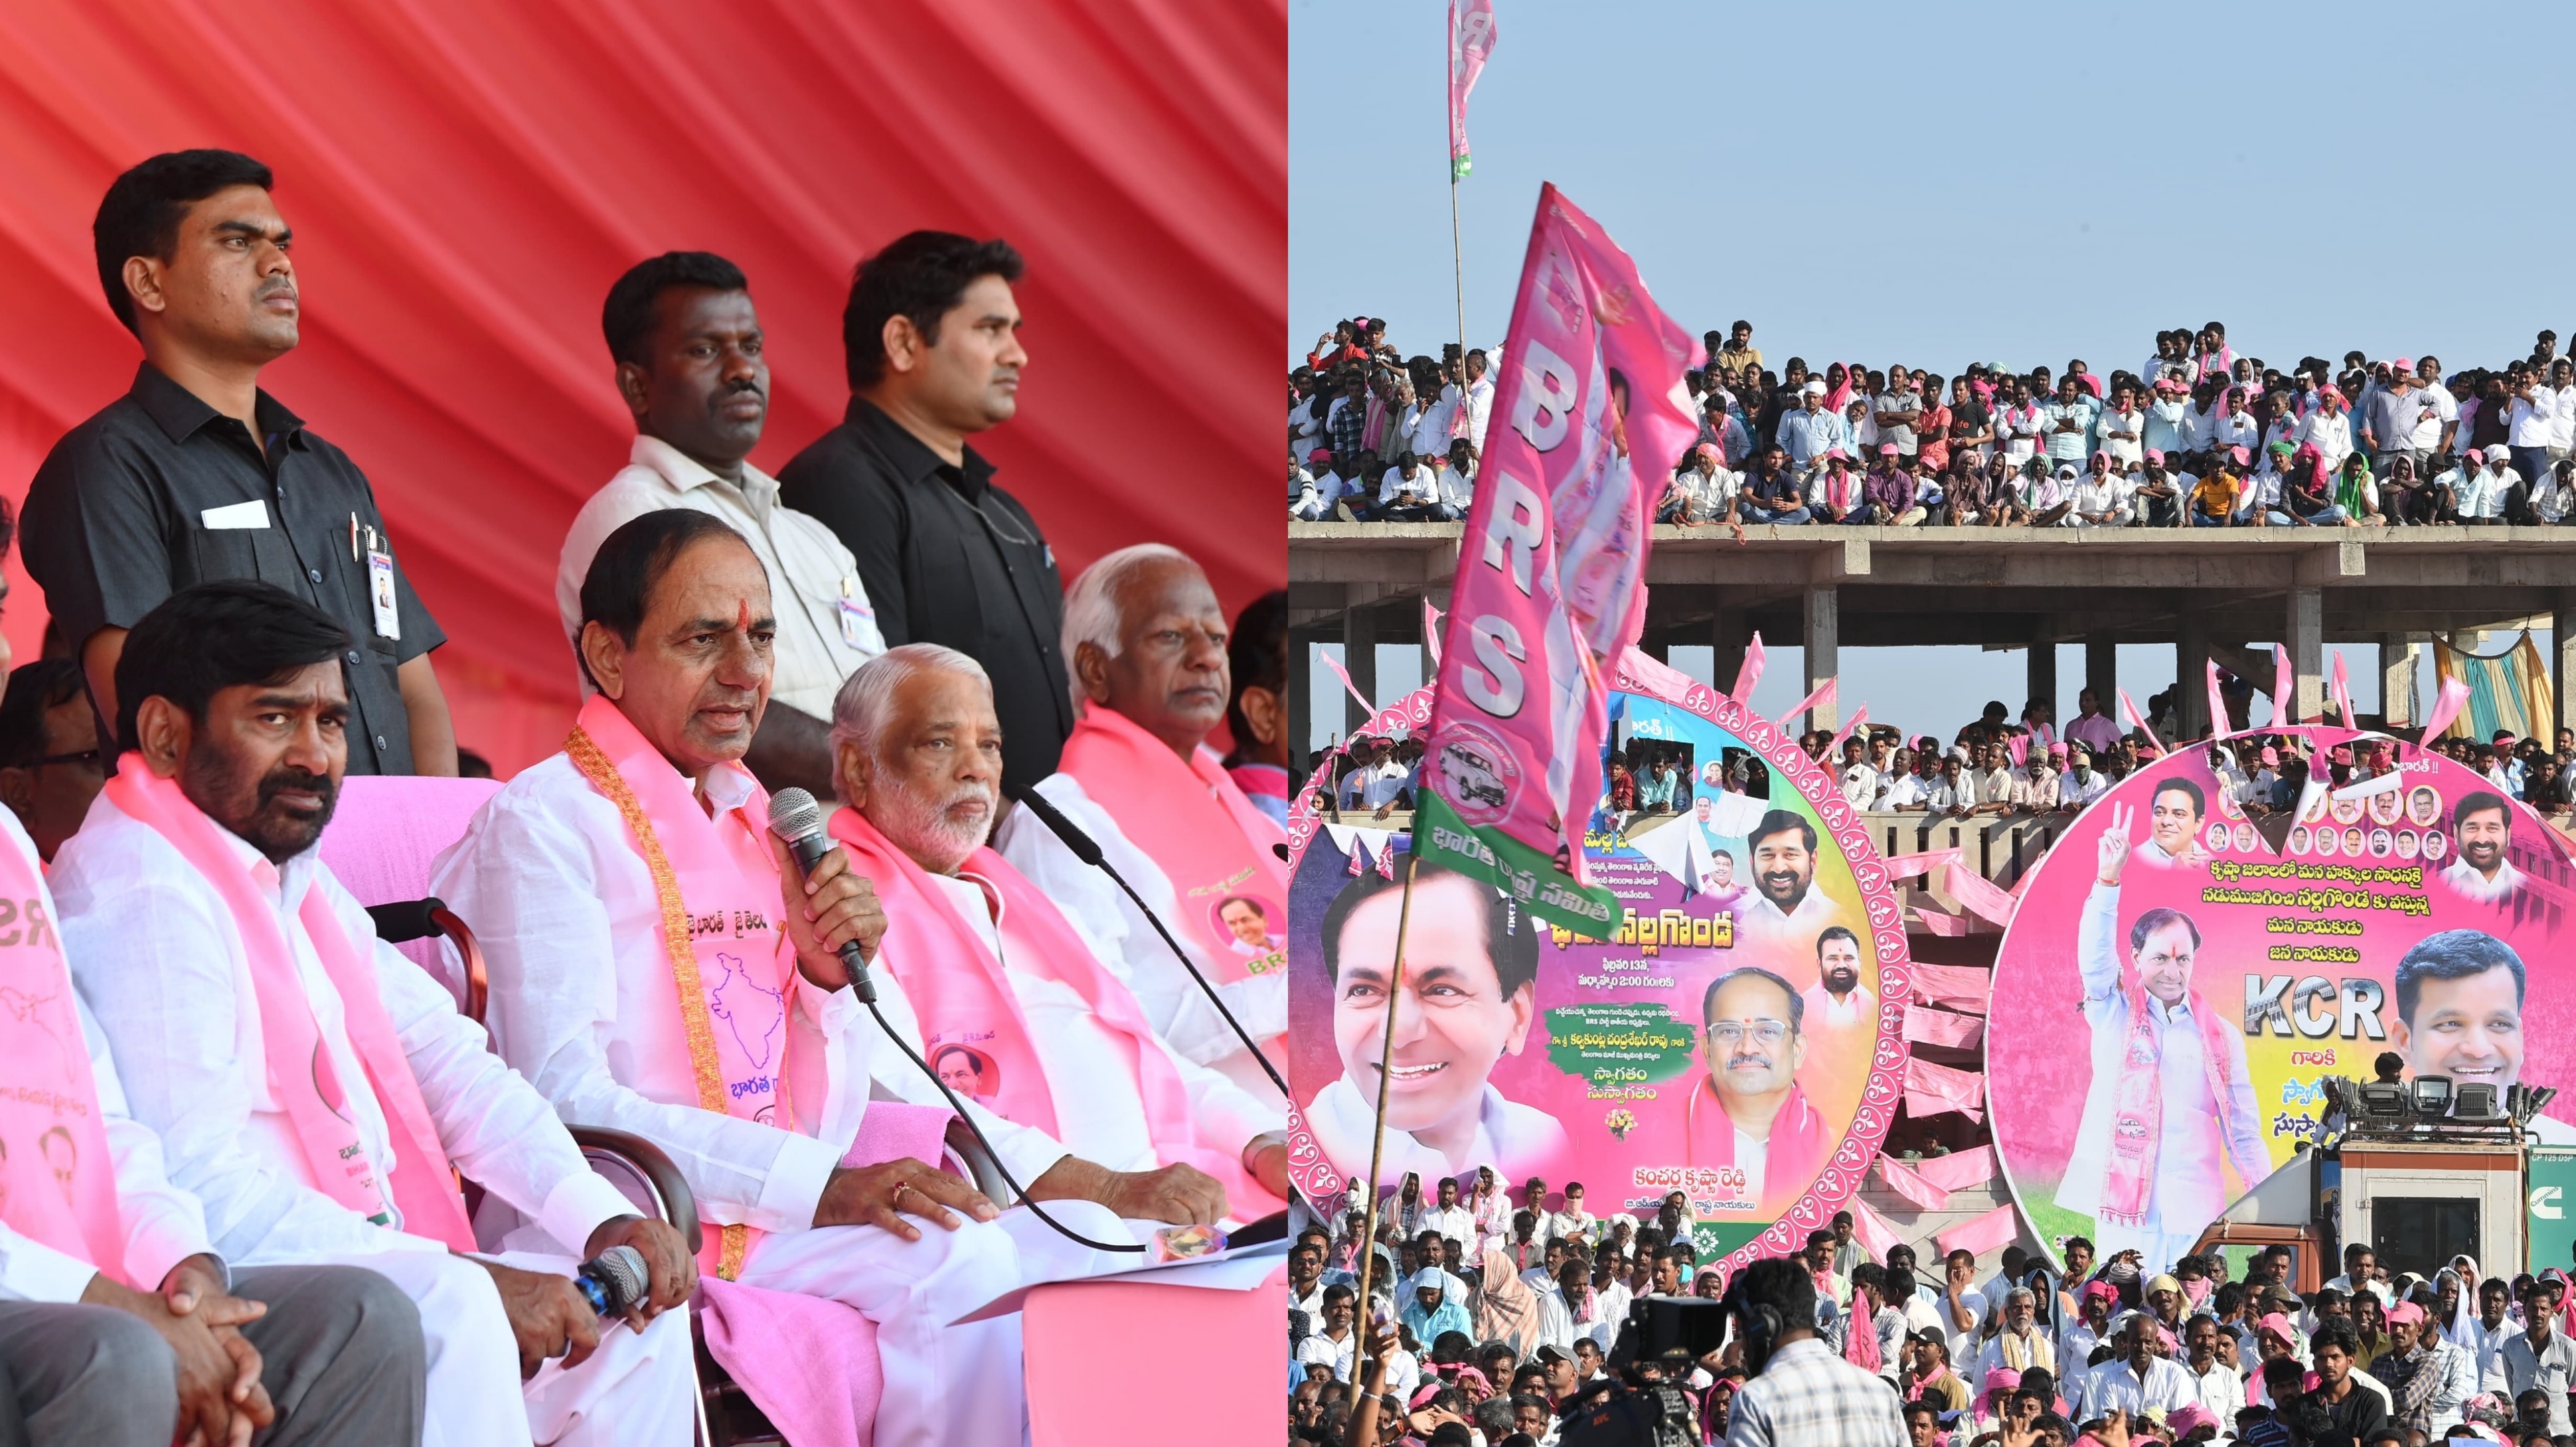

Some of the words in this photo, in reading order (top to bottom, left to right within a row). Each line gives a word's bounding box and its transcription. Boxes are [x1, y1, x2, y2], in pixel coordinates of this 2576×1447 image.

[1461, 339, 1578, 719] BRS
[1633, 718, 1662, 735] ారత్
[2210, 861, 2240, 881] కృష్ణా
[2242, 861, 2296, 877] జలాలలో
[2298, 865, 2324, 879] మన
[2326, 864, 2372, 885] హక్కుల
[2374, 867, 2422, 888] సాధనకై
[2202, 887, 2295, 907] నడుముబిగించి
[2298, 888, 2370, 912] నల్లగొండ
[2372, 895, 2388, 910] కు
[2389, 895, 2431, 915] వస్తున్న
[696, 911, 724, 937] భారత్
[1616, 907, 1734, 956] నల్లగొండ
[2267, 917, 2295, 933] మన
[2296, 918, 2363, 936] నాయకుడు
[2269, 945, 2292, 961] జన
[2293, 946, 2360, 963] నాయకుడు
[1602, 957, 1629, 972] ఫిబ్రవరి
[1619, 976, 1642, 987] 2:00
[2243, 973, 2387, 1040] KCR
[1607, 1030, 1648, 1050] చంద్రశేఖర్
[1649, 1034, 1668, 1049] రావు
[2291, 1048, 2336, 1066] గారికి
[1594, 1067, 1647, 1085] స్వాగతం
[1587, 1086, 1657, 1104] సుస్వాగతం
[2281, 1078, 2326, 1104] స్వాగ
[1635, 1168, 1682, 1189] కంచర్ల
[1685, 1169, 1718, 1193] కృష్ణా
[1721, 1168, 1746, 1194] రెడ్డి
[2530, 1186, 2559, 1207] Cummins
[1694, 1201, 1713, 1214] రాష్ట్ర
[1714, 1201, 1755, 1210] నాయకులు
